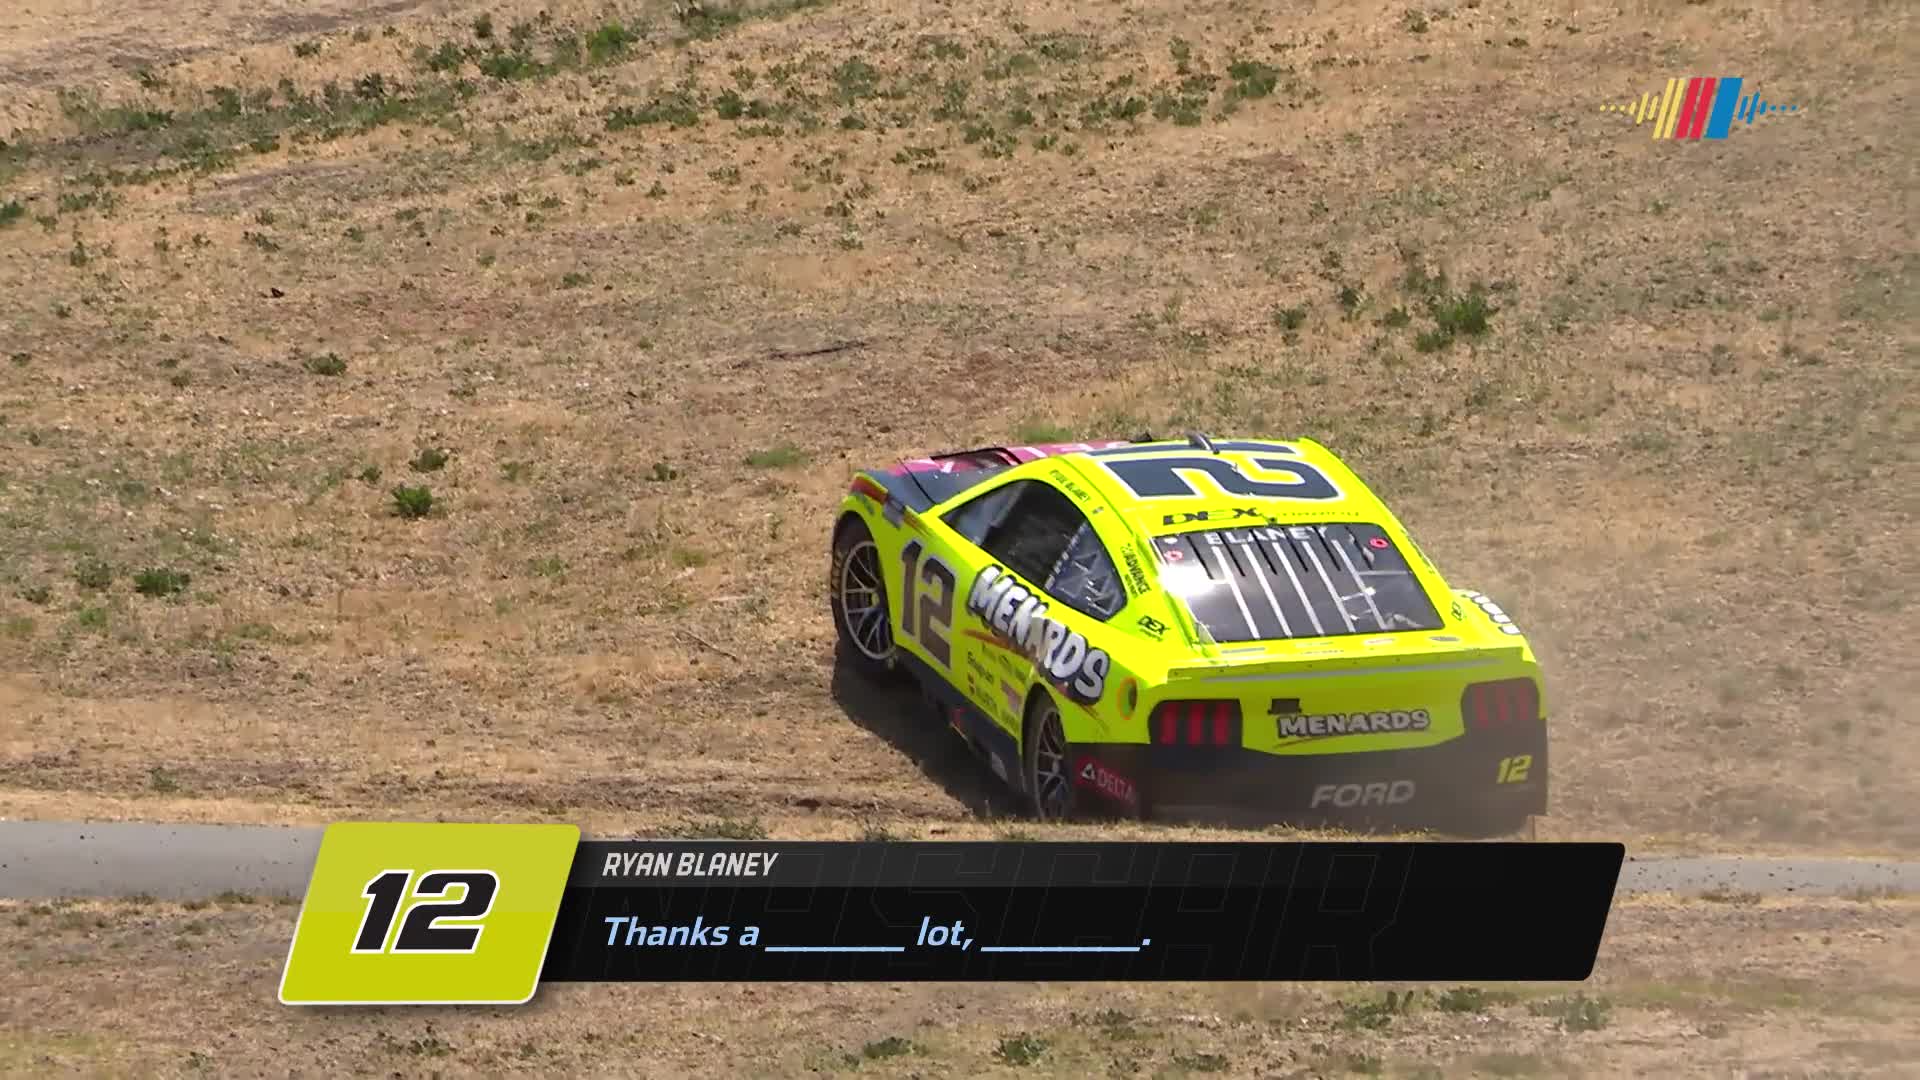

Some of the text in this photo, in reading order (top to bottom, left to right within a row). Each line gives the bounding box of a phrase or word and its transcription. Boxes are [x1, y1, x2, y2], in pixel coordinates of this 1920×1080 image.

[1204, 525, 1329, 546] BLANEY
[900, 540, 957, 674] 12
[967, 563, 1111, 706] MENARDS
[1138, 615, 1171, 635] DEX
[1276, 709, 1431, 738] MENARDS
[1496, 754, 1533, 784] 12
[1096, 767, 1136, 806] DELTA
[1311, 780, 1415, 808] FORD
